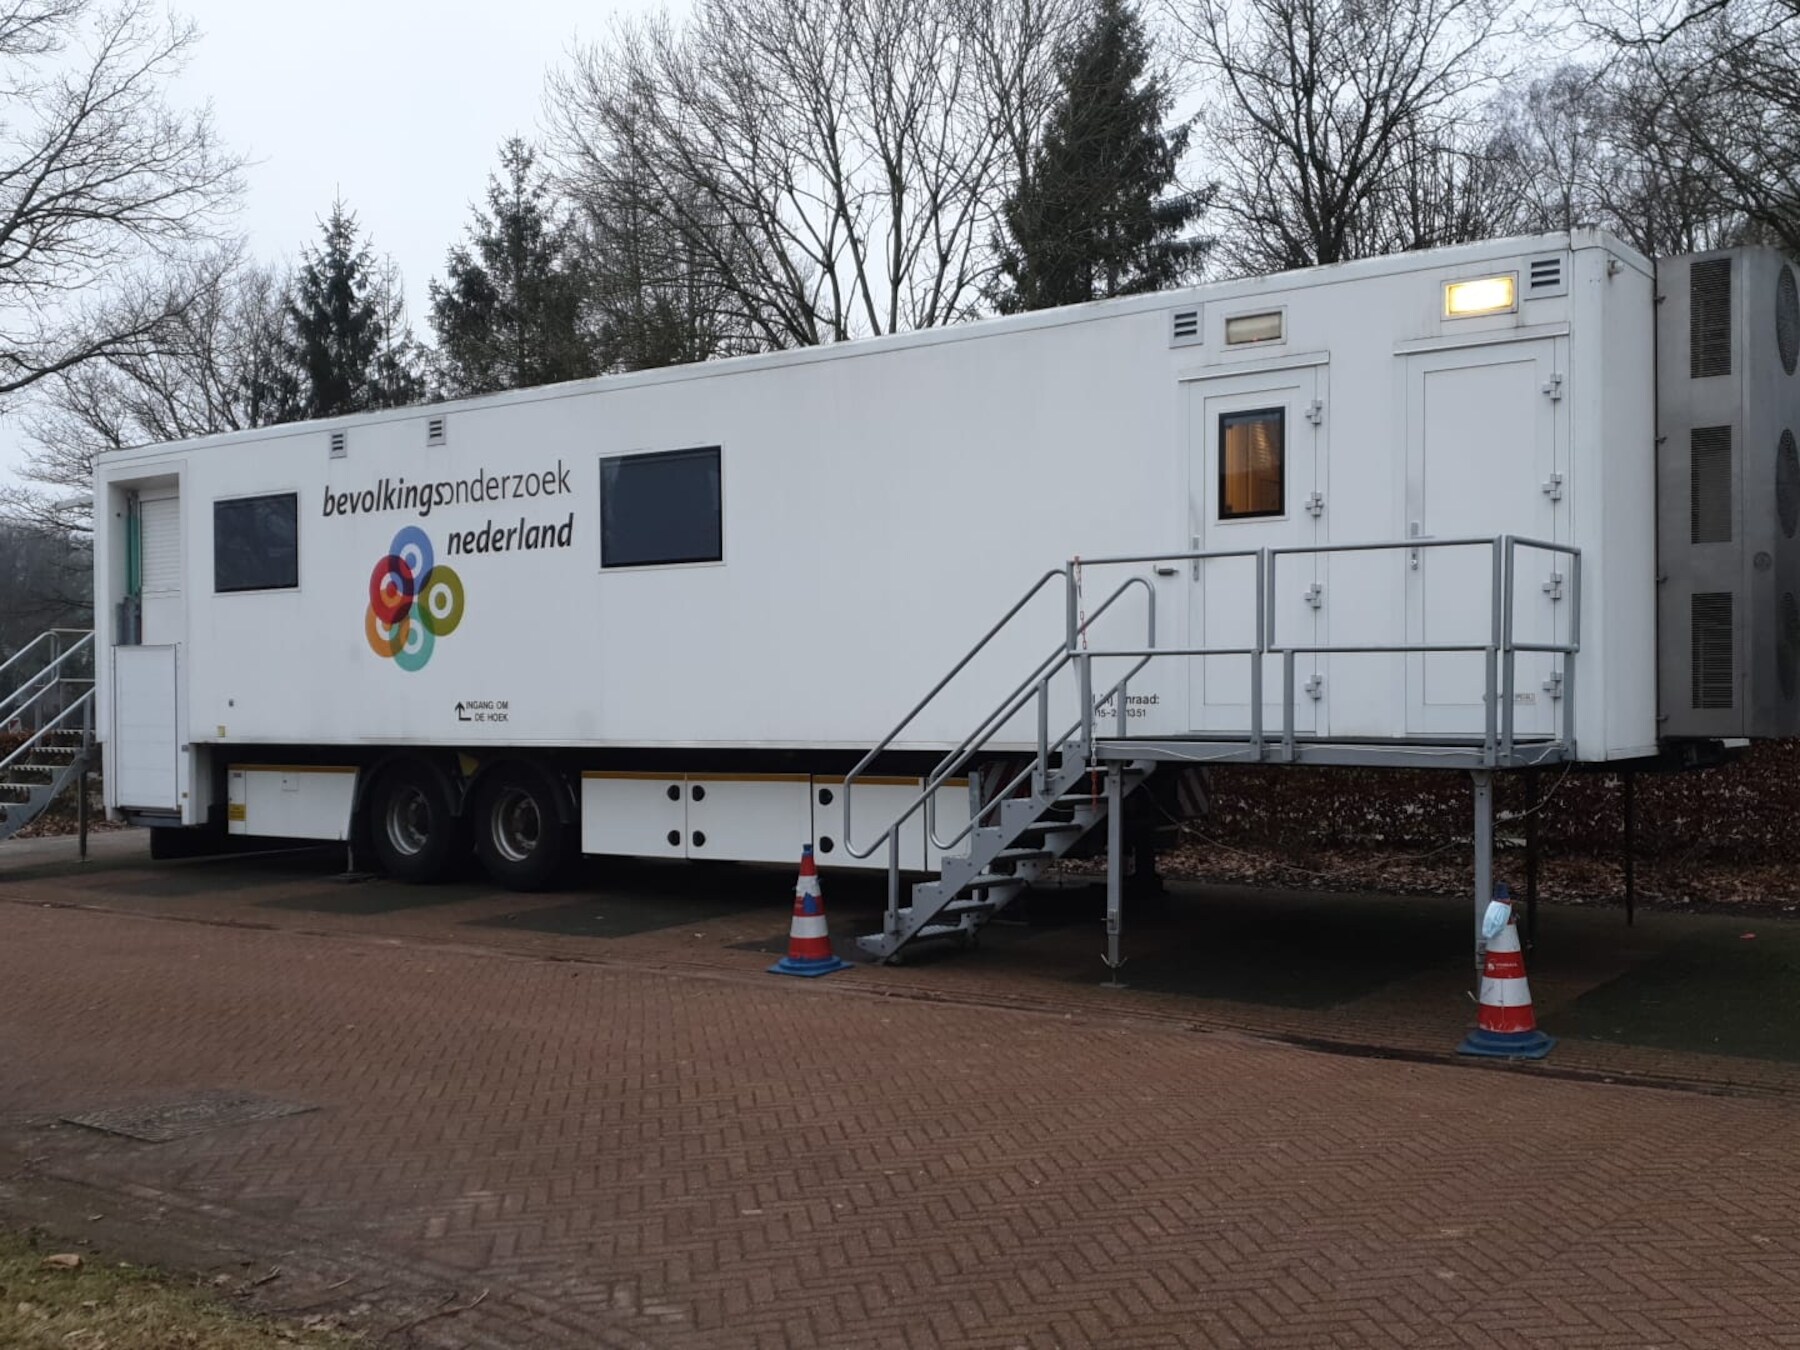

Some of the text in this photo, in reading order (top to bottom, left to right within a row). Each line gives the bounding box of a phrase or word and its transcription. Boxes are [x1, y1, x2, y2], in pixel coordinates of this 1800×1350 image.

[322, 459, 572, 517] bevolkingsonderzoek
[447, 512, 574, 555] nederland
[1117, 694, 1160, 704] nraad:
[466, 701, 508, 709] INGANG OM
[475, 713, 508, 721] DE HOEK
